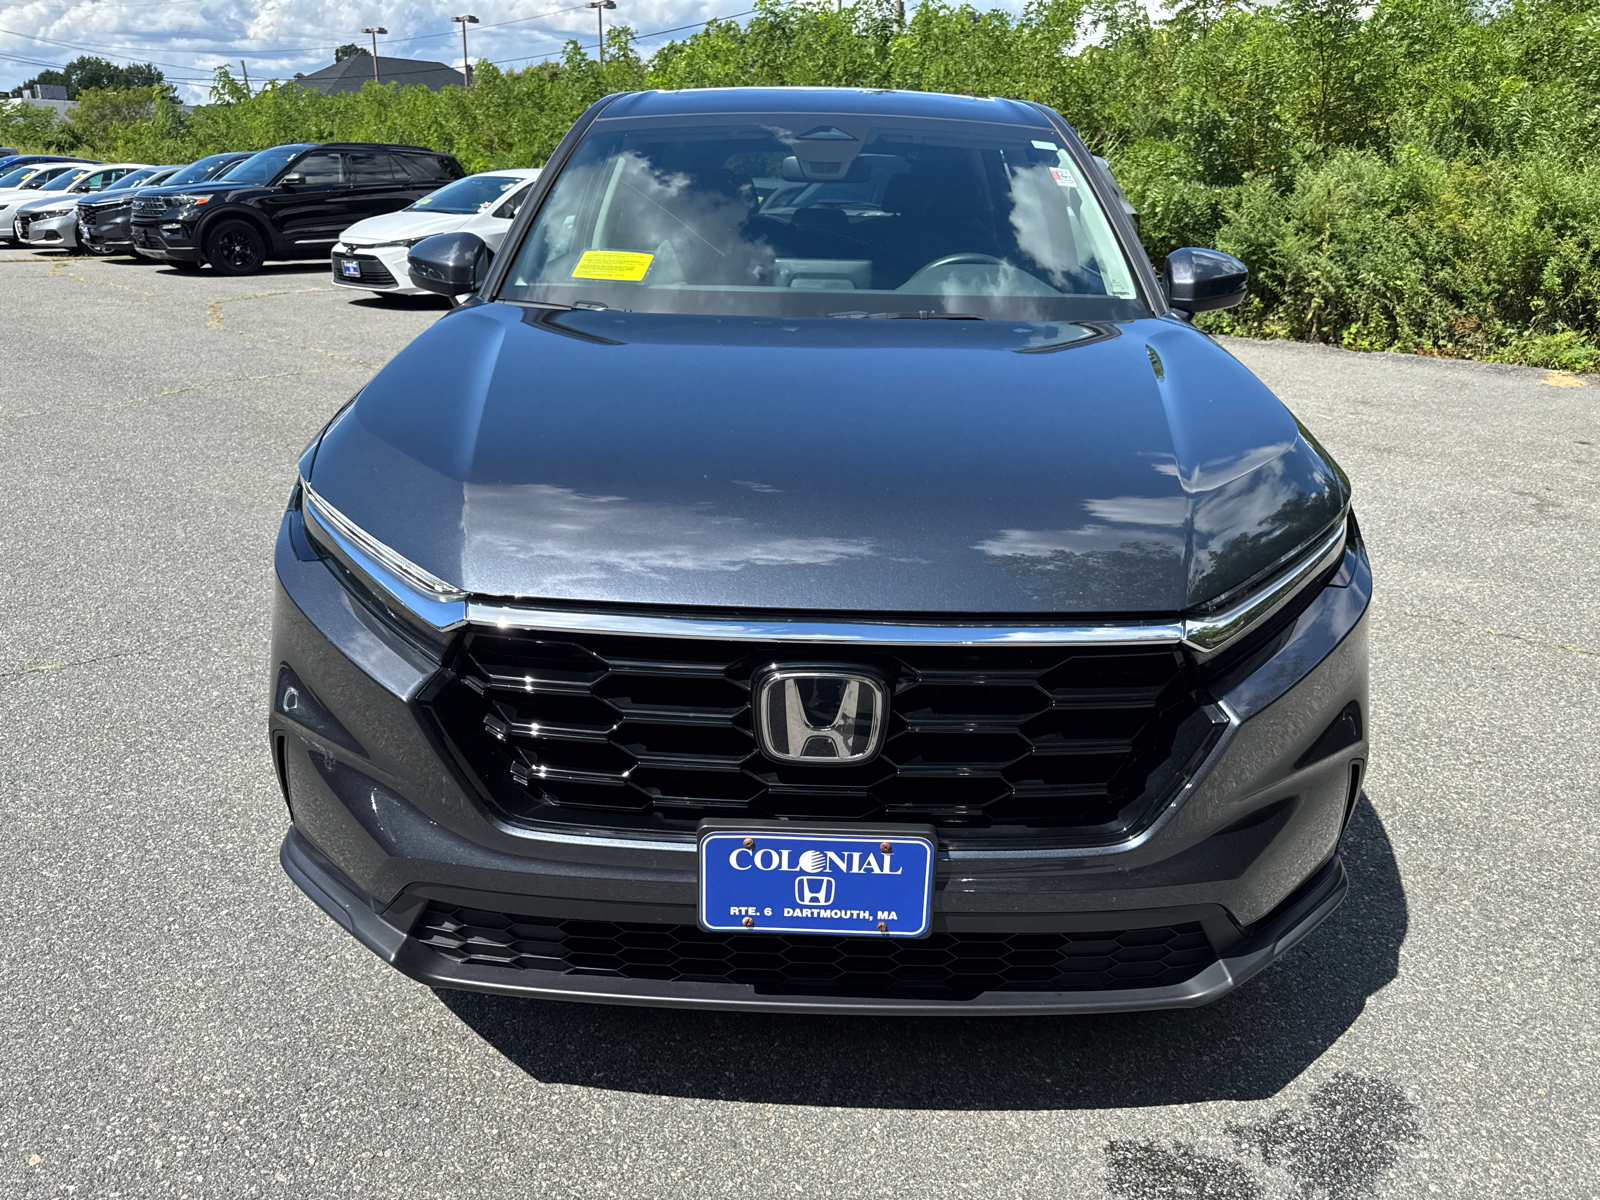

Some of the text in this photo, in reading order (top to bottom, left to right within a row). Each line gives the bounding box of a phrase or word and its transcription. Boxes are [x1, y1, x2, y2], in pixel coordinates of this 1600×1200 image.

[729, 848, 902, 874] COLONIAL
[730, 906, 898, 921] RTE. 6 DARTMOUTH, MA
